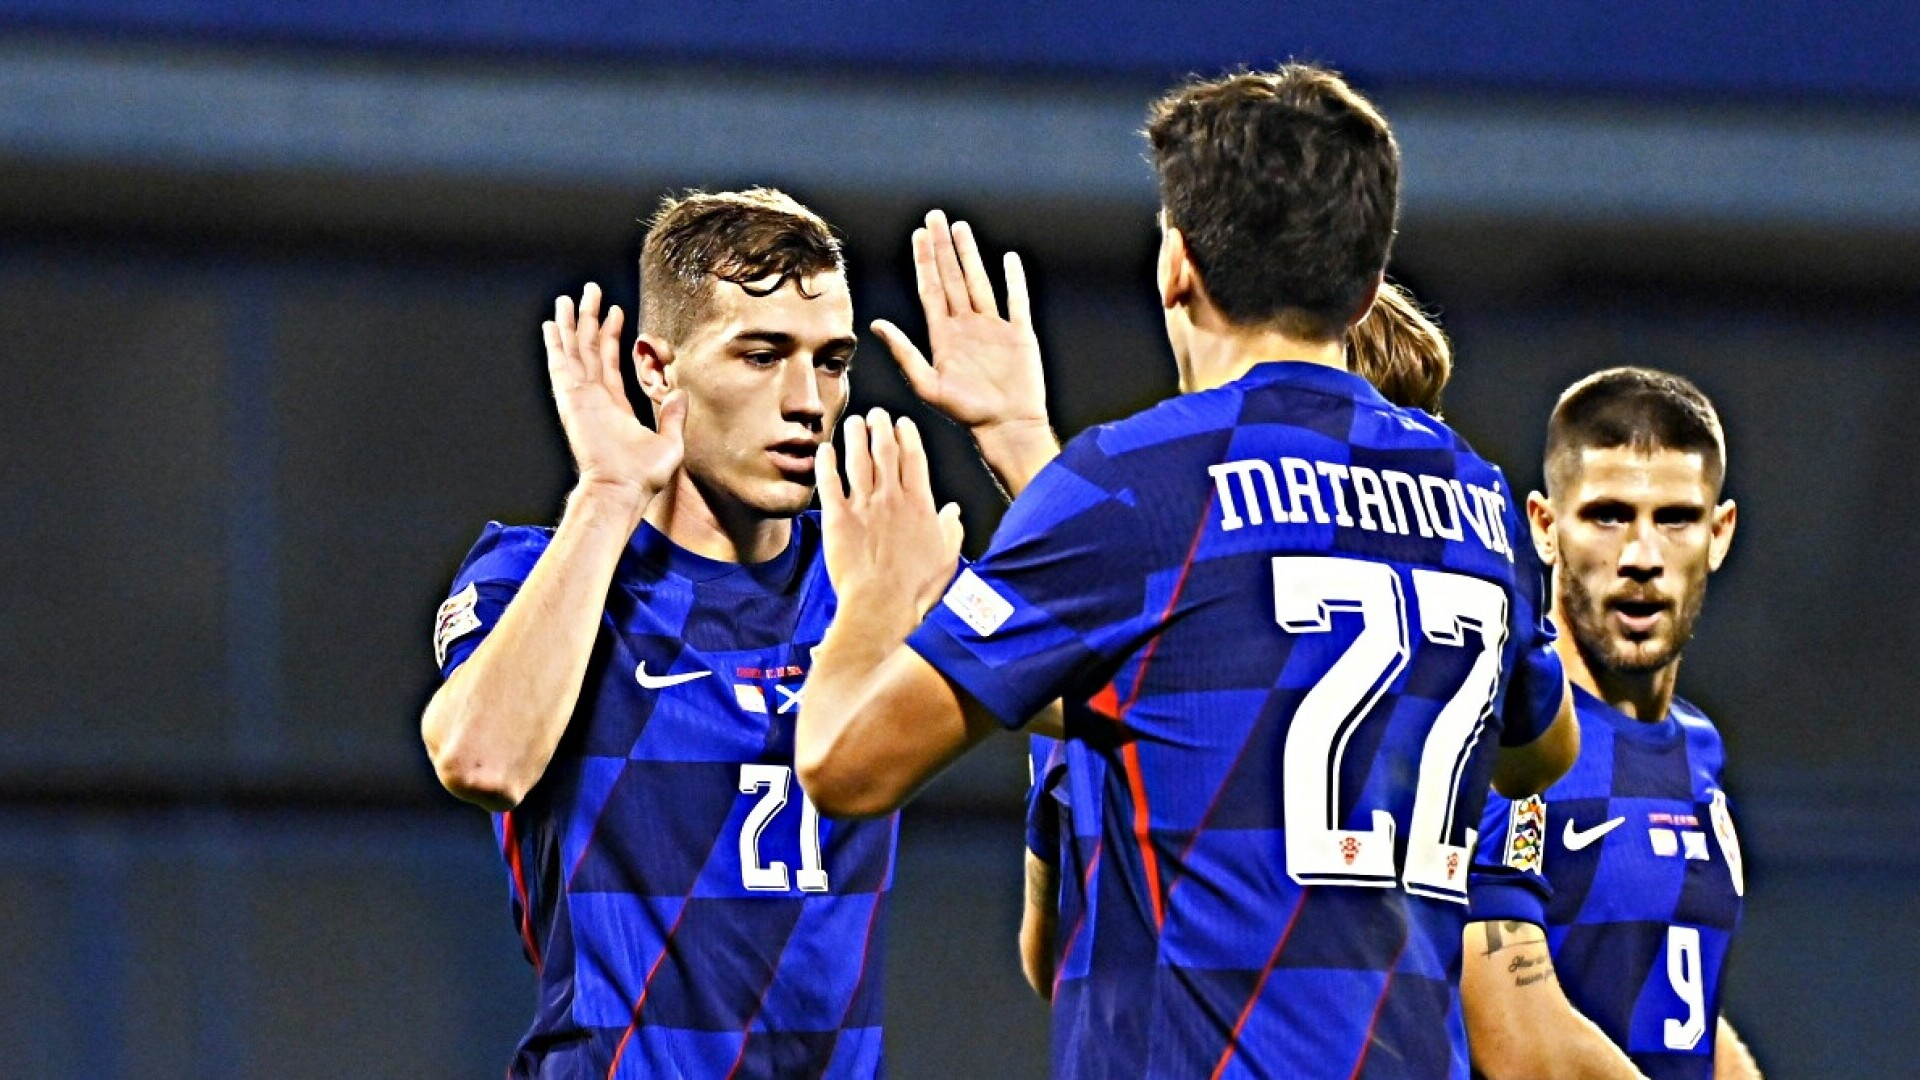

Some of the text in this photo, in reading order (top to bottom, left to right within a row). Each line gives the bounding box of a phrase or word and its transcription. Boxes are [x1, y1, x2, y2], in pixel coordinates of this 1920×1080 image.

[1272, 556, 1509, 904] 22
[739, 763, 828, 892] 21
[1664, 925, 1706, 1050] 9
